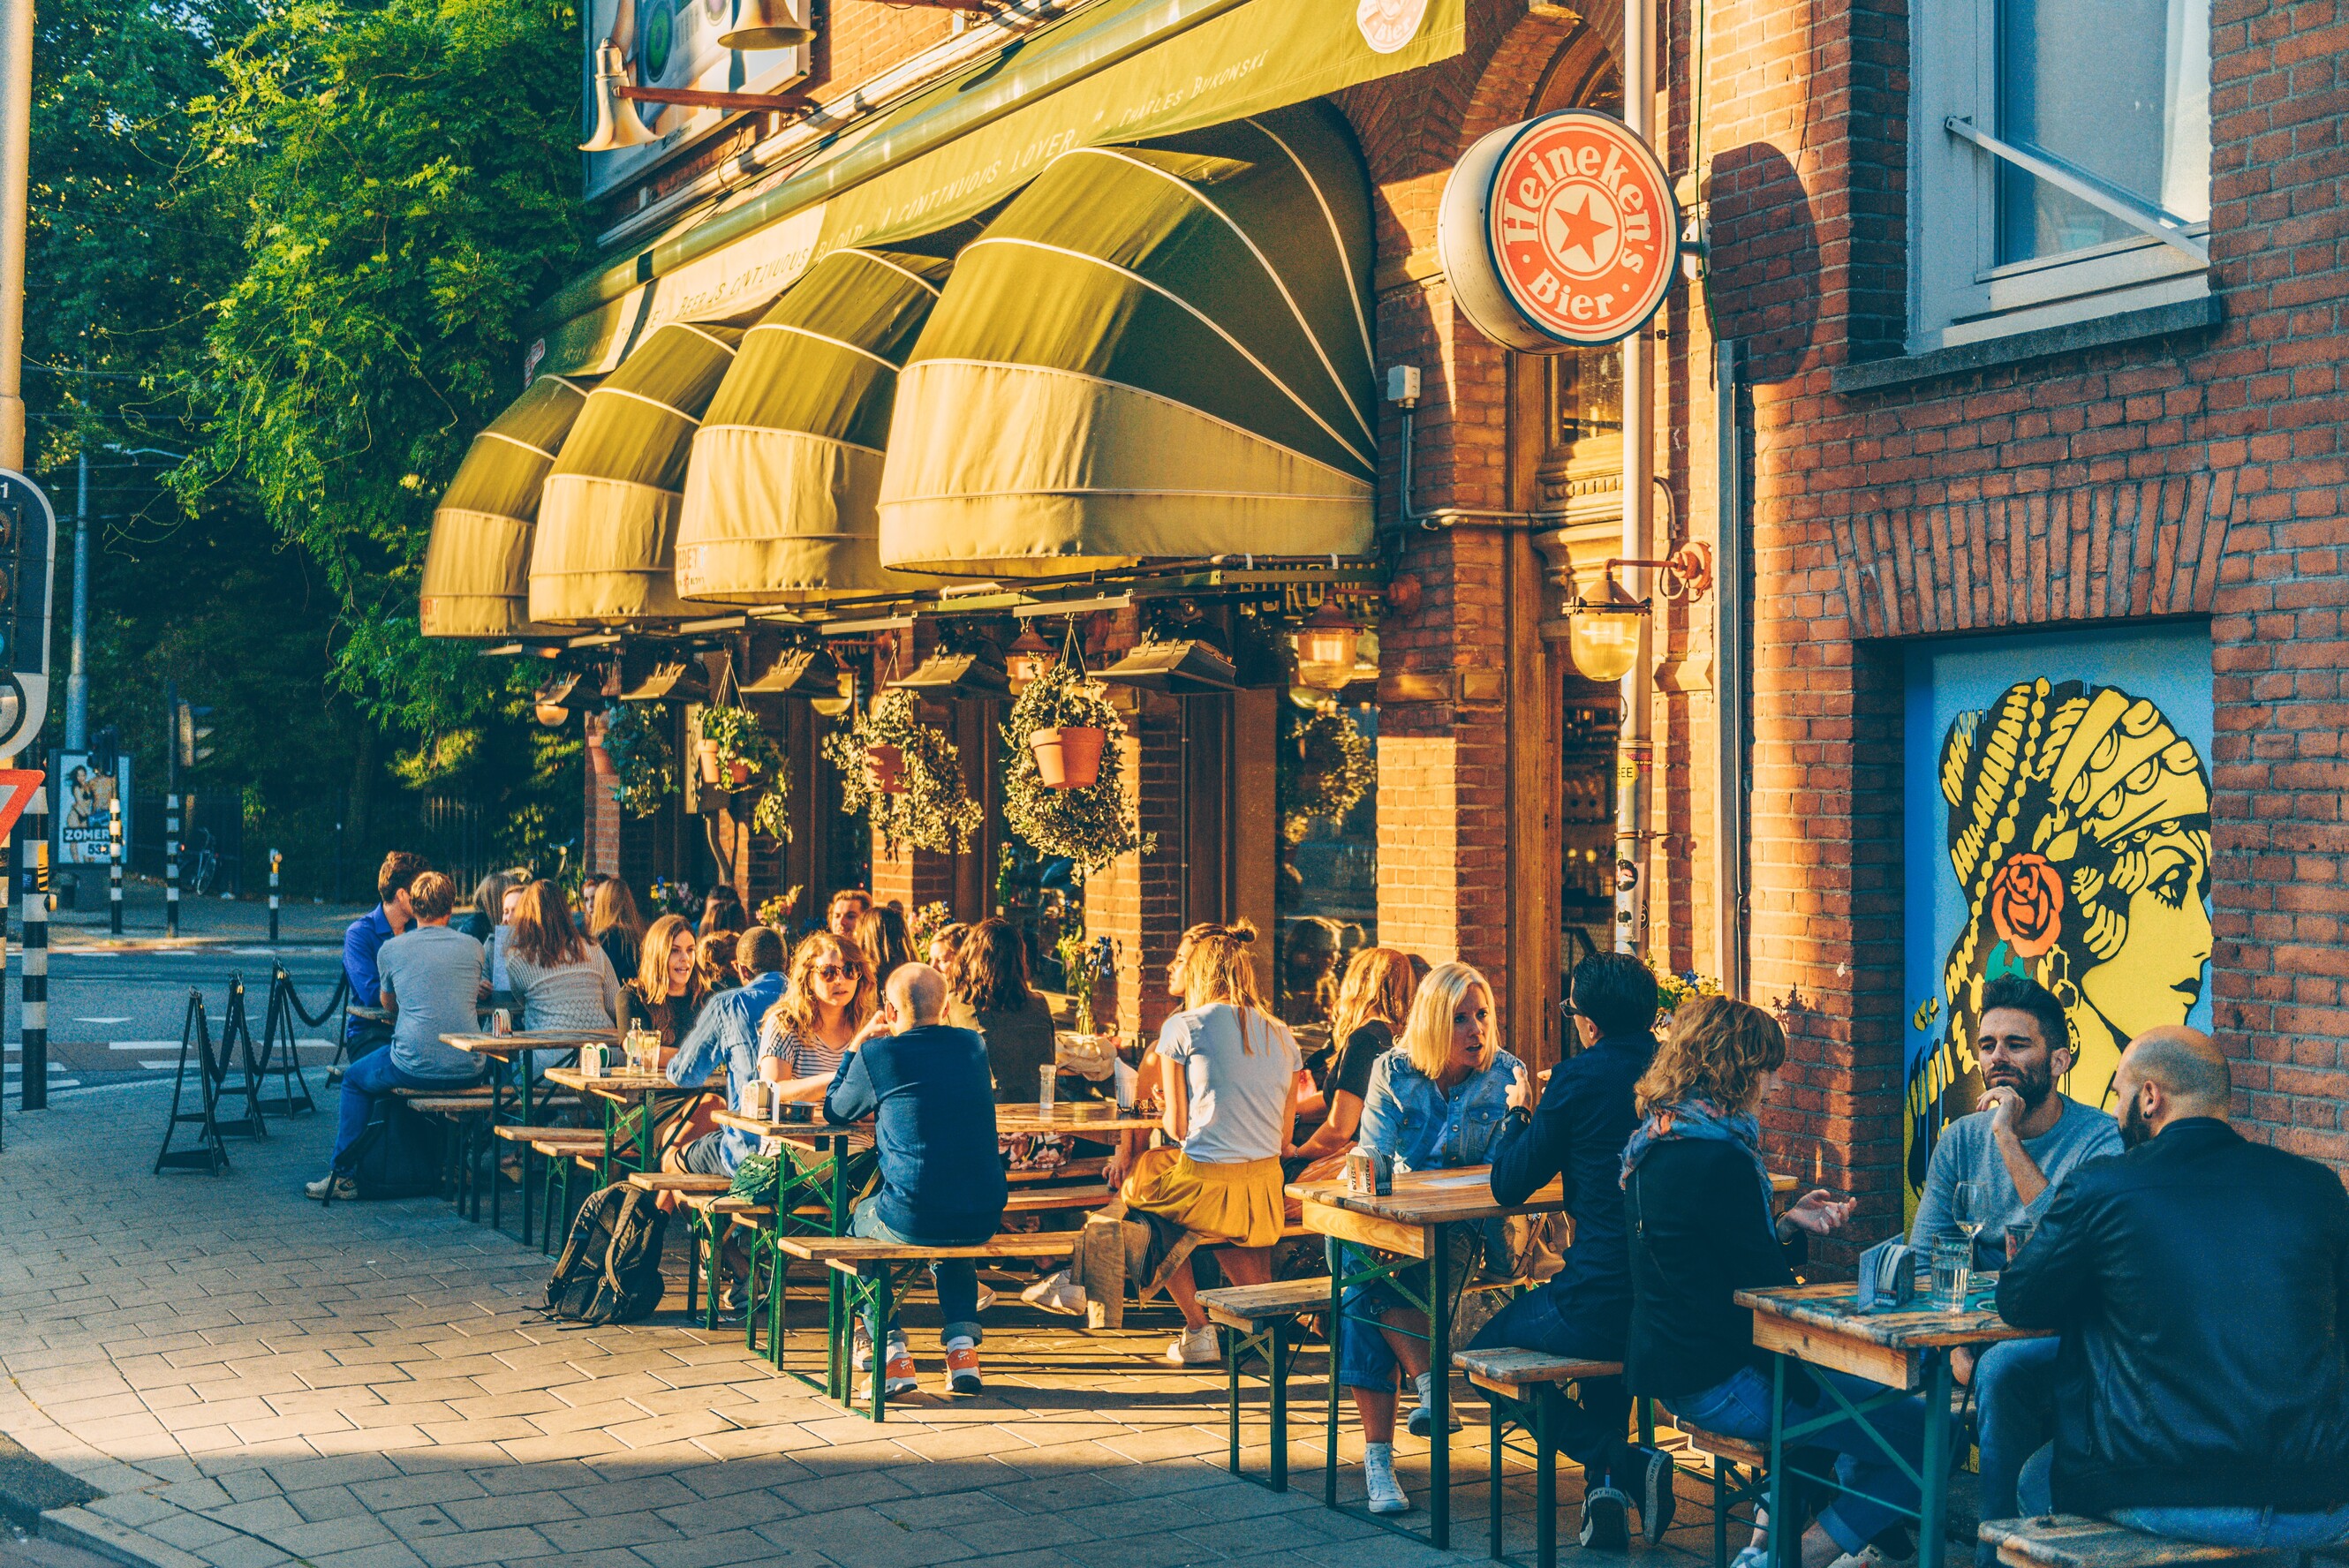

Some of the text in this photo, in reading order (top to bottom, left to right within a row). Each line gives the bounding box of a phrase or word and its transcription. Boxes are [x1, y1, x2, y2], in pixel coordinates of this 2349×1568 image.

[896, 160, 1002, 224] CONTINUOUS
[1503, 143, 1655, 275] Heineken's
[1526, 268, 1615, 320] Bier
[64, 828, 110, 841] ZOMER
